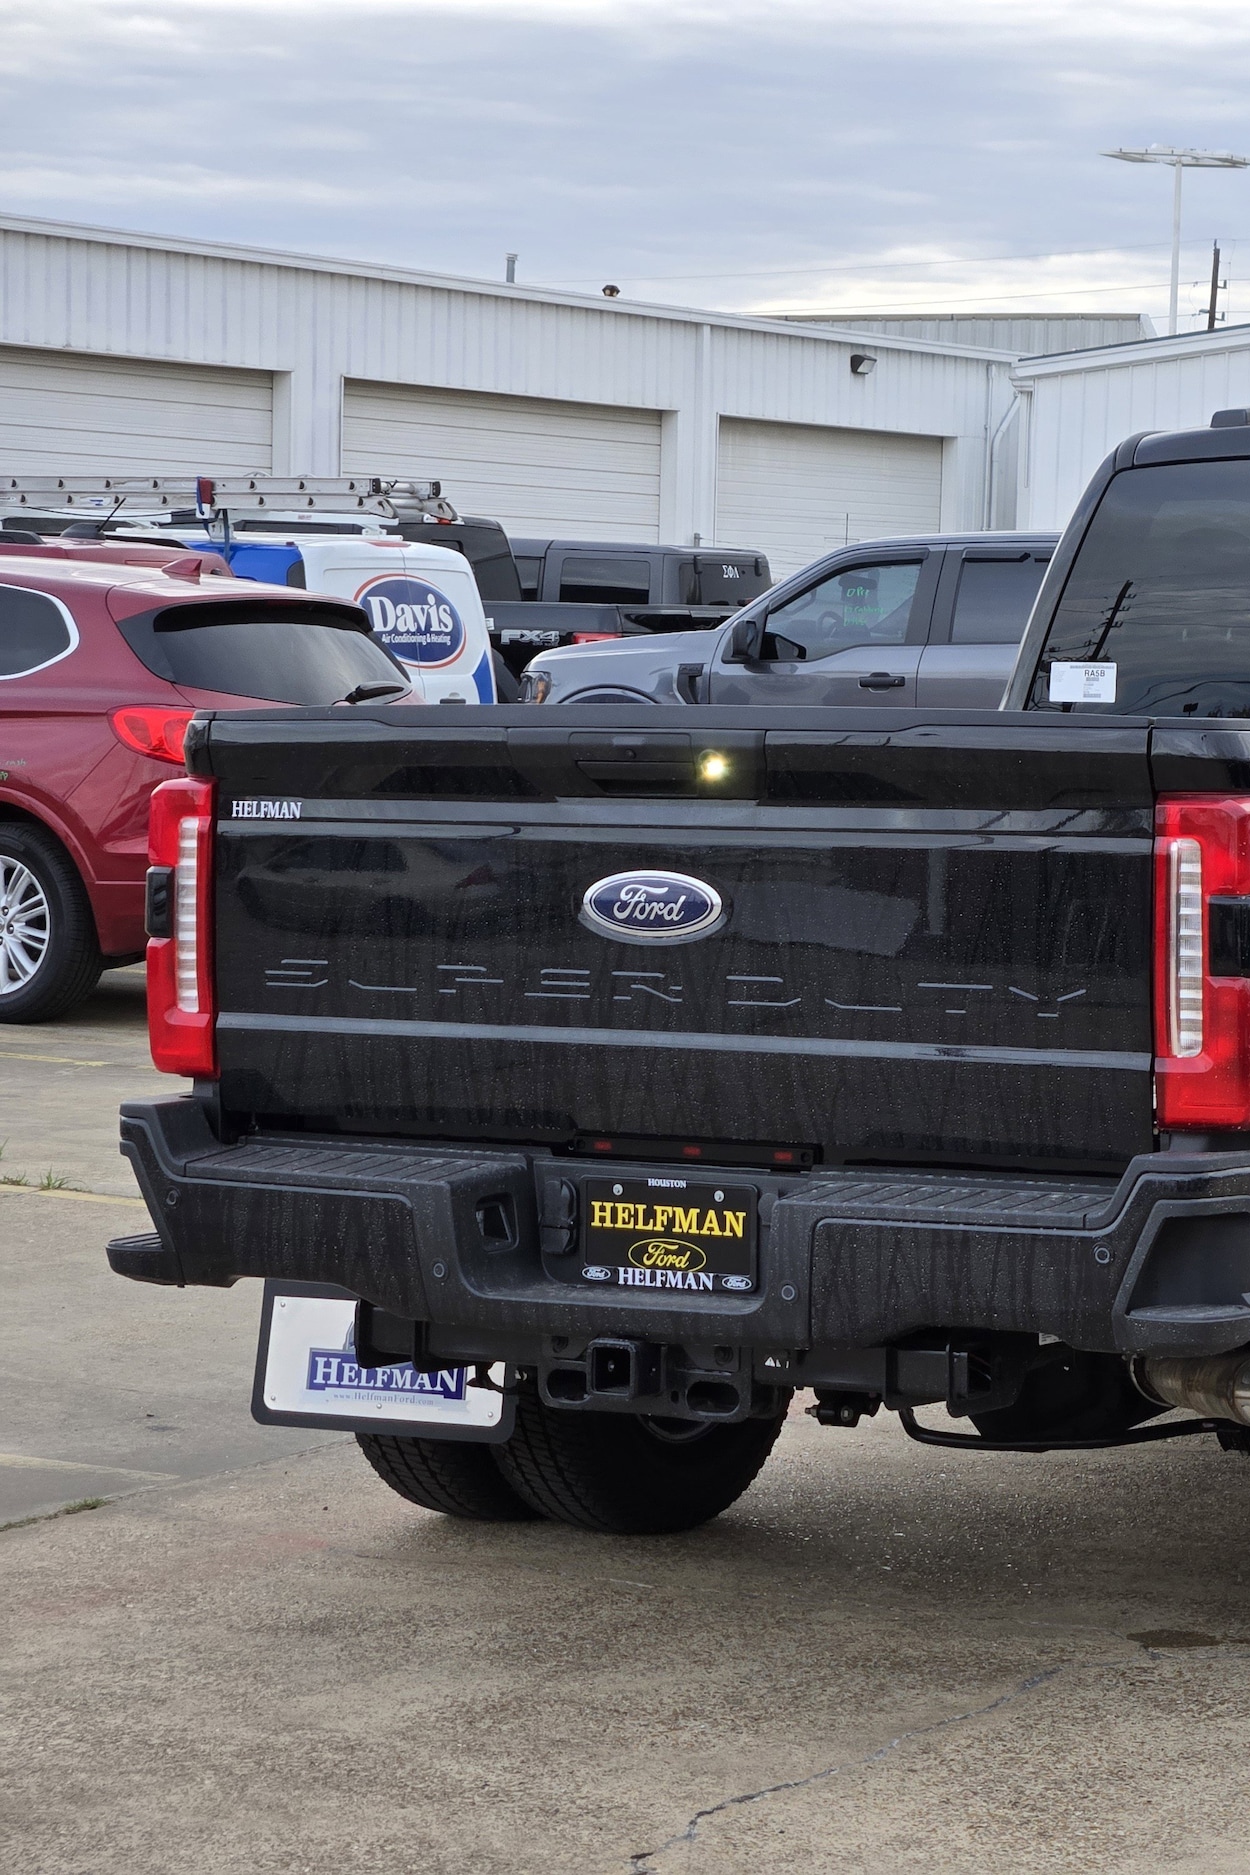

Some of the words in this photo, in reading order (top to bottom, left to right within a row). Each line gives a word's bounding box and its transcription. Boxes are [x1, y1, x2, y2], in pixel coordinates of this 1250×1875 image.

[366, 593, 454, 633] Davis
[381, 633, 391, 643] Air
[391, 633, 427, 646] Conditioning
[430, 633, 452, 646] Heating
[500, 629, 560, 645] FX4
[231, 800, 302, 819] HELFMAN
[613, 884, 687, 921] Ford
[264, 957, 684, 1004] SUPER
[724, 974, 1089, 1018] DUTY
[647, 1178, 688, 1189] HOUSTON
[590, 1200, 747, 1238] HELFMAN
[642, 1242, 692, 1269] Ford
[585, 1269, 607, 1279] Ford
[617, 1266, 714, 1291] HELFMAN
[726, 1278, 747, 1288] Ford
[313, 1356, 460, 1393] HELFMAN
[333, 1391, 435, 1406] www.HelfmanFord.com
